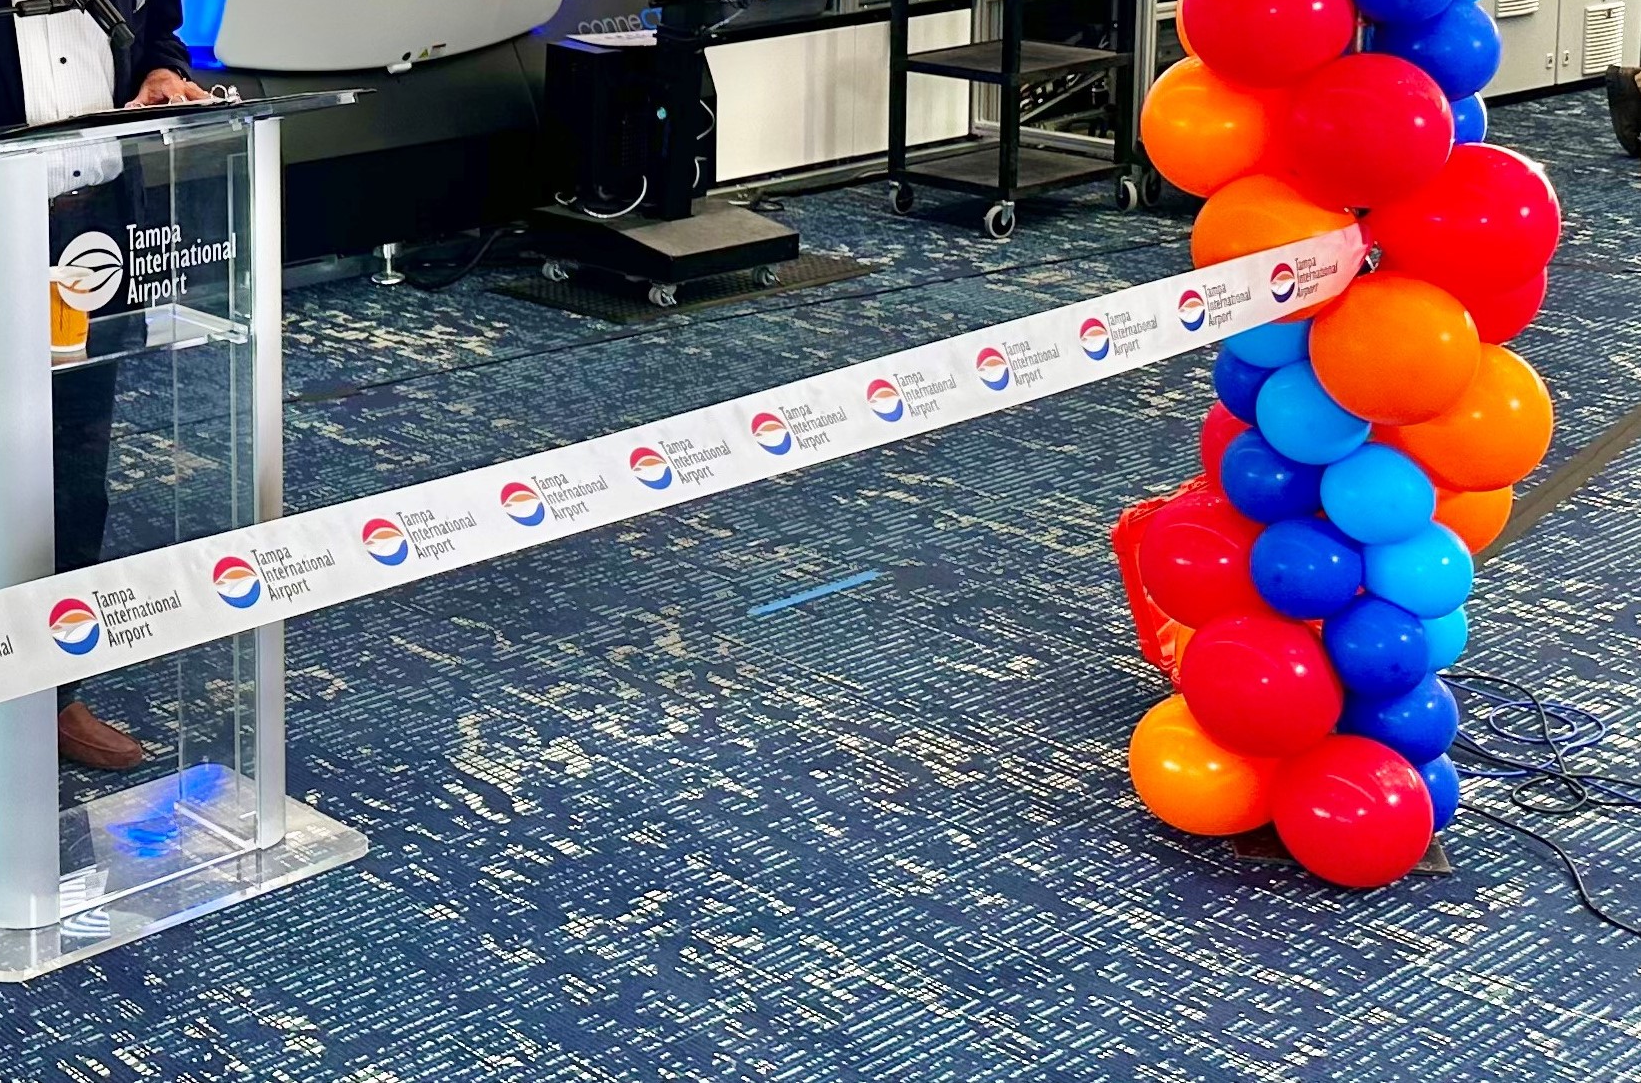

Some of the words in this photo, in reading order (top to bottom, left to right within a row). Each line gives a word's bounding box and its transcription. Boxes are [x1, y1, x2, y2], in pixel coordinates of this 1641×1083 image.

[126, 223, 182, 252] Tampa
[129, 232, 236, 277] International
[126, 272, 188, 307] Airport
[1002, 341, 1031, 357] Tampa
[1008, 343, 1060, 371] International
[893, 371, 925, 388] Tampa
[901, 373, 957, 402] International
[1013, 368, 1043, 388] Airport
[778, 404, 813, 421] Tampa
[787, 405, 848, 435] International
[907, 399, 940, 419] Airport
[658, 438, 694, 456] Tampa
[795, 431, 831, 451] Airport
[668, 439, 732, 470] International
[530, 473, 570, 491] Tampa
[676, 465, 715, 486] Airport
[541, 474, 609, 506] International
[396, 509, 436, 528] Tampa
[549, 500, 590, 522] Airport
[405, 510, 477, 544] International
[250, 547, 293, 566] Tampa
[413, 537, 456, 561] Airport
[259, 548, 336, 584] International
[91, 587, 136, 609] Tampa
[267, 577, 311, 604] Airport
[100, 589, 182, 628] International
[106, 620, 154, 649] Airport
